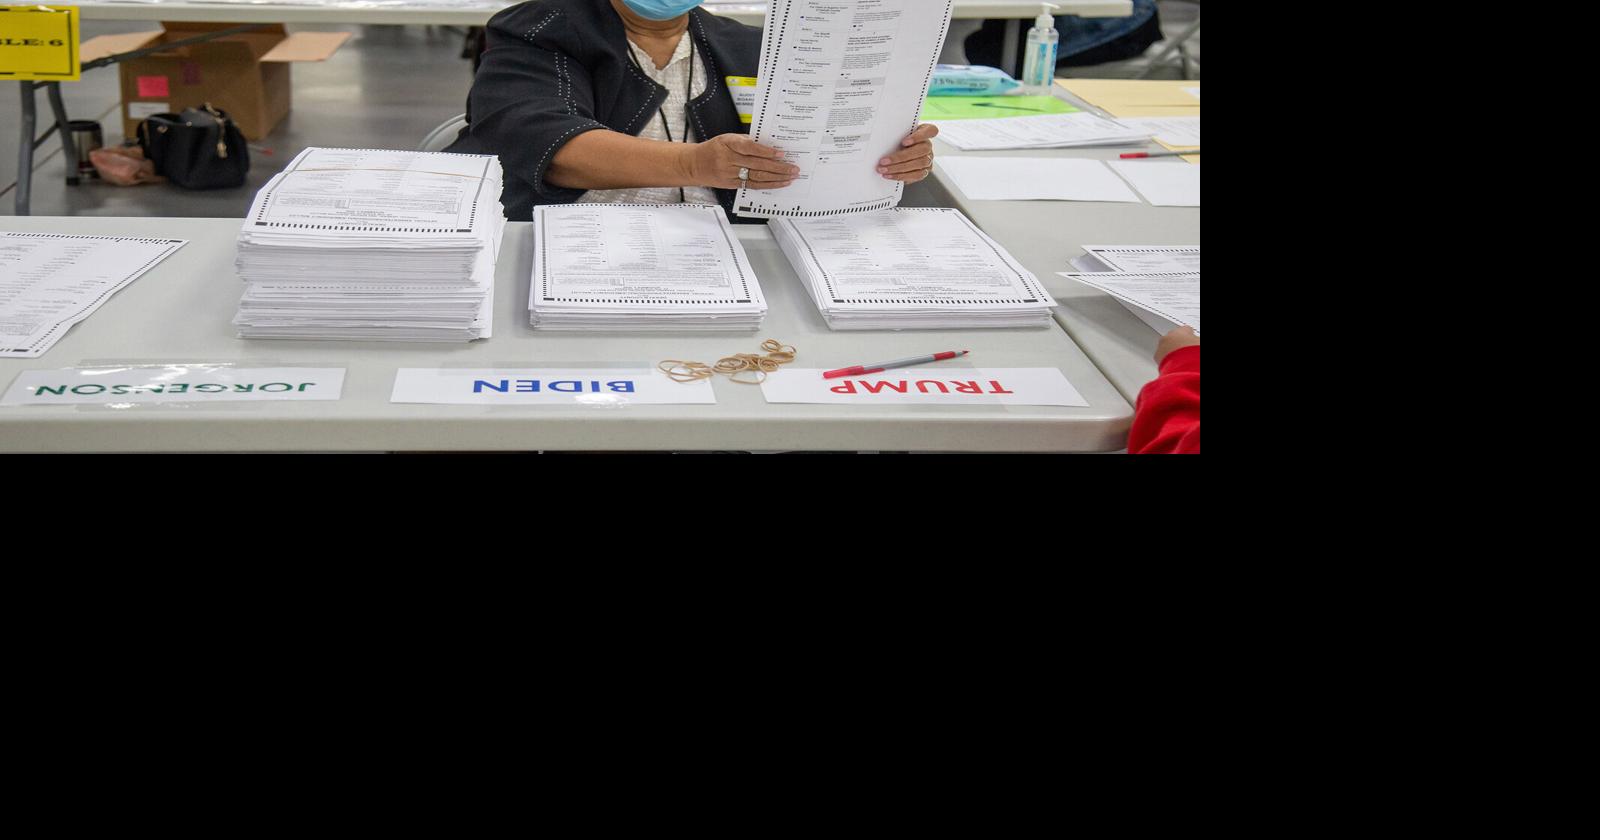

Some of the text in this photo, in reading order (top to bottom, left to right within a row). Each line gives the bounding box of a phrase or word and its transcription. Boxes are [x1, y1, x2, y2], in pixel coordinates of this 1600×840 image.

[34, 382, 317, 396] JORGENSON
[473, 379, 635, 393] BIDEN
[829, 380, 1014, 394] TRUMP
